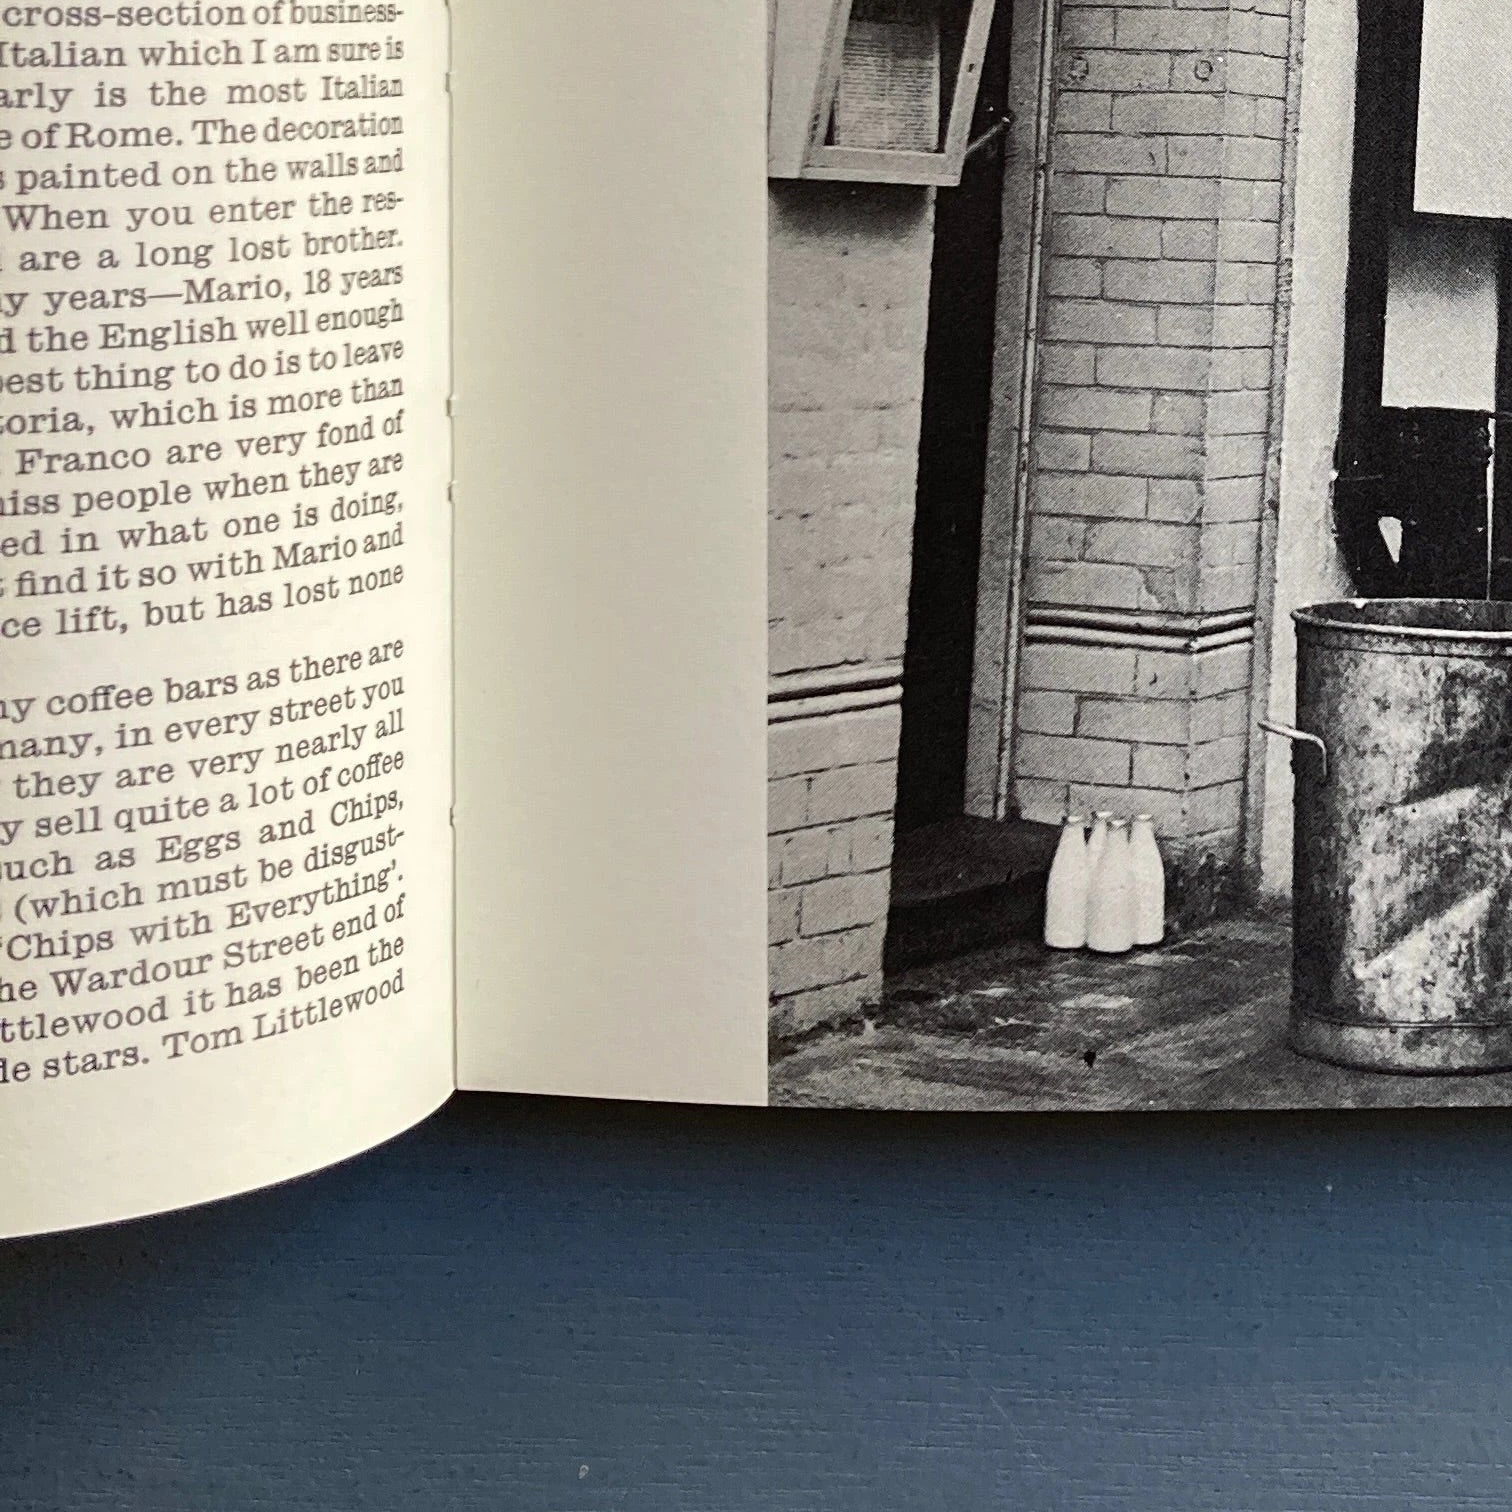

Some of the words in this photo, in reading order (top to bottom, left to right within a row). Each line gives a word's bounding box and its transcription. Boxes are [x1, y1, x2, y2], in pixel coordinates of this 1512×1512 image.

[2, 0, 247, 26] cross-section
[290, 0, 403, 24] business-
[138, 40, 243, 66] which
[274, 44, 321, 63] am
[327, 42, 380, 61] sure
[386, 36, 403, 60] is
[149, 81, 206, 106] the
[226, 79, 306, 104] most
[321, 75, 403, 100] Italian
[65, 123, 182, 148] Rome.
[192, 119, 256, 144] The
[263, 113, 403, 142] decoration
[16, 161, 162, 195] painted
[172, 166, 215, 185] on
[225, 158, 276, 182] the
[286, 153, 358, 179] walls
[364, 148, 404, 174] and
[2, 204, 110, 231] When
[126, 207, 194, 232] you
[210, 198, 296, 223] enter
[308, 192, 352, 216] the
[362, 192, 403, 212] res-
[19, 251, 81, 271] are
[136, 242, 214, 268] long
[229, 235, 290, 262] lost
[303, 226, 402, 256] brother.
[305, 269, 331, 294] 18
[340, 266, 402, 295] years
[26, 326, 88, 352] the
[99, 316, 238, 351] English
[246, 310, 309, 338] well
[316, 298, 404, 331] enough
[74, 363, 175, 390] thing
[230, 354, 266, 380] do
[344, 341, 403, 367] leave
[110, 398, 218, 428] which
[229, 394, 257, 420] is
[267, 389, 342, 415] more
[351, 378, 403, 404] than
[16, 448, 151, 475] Franco
[167, 442, 222, 464] are
[235, 432, 307, 457] very
[317, 416, 375, 448] fond
[72, 480, 191, 517] people
[203, 473, 289, 500] when
[299, 462, 361, 488] they
[368, 453, 403, 476] are
[61, 528, 100, 553] in
[117, 517, 207, 548] what
[224, 514, 280, 537] one
[293, 503, 318, 528] is
[331, 492, 402, 522] doing,
[15, 567, 88, 597] find
[139, 565, 176, 587] so
[187, 550, 265, 581] with
[273, 536, 356, 570] Mario
[363, 522, 404, 553] and
[56, 606, 127, 634] lift,
[142, 597, 204, 626] but
[216, 592, 272, 618] has
[284, 576, 339, 608] lost
[348, 565, 403, 595] none
[47, 685, 153, 715] coffee
[164, 675, 238, 704] bars
[247, 668, 280, 691] as
[289, 652, 362, 682] there
[369, 640, 403, 665] are
[0, 733, 103, 760] many,
[165, 710, 260, 742] every
[270, 686, 355, 726] street
[362, 677, 404, 709] you
[13, 772, 102, 799] they
[116, 764, 174, 788] are
[188, 748, 264, 778] very
[275, 724, 367, 763] nearly
[376, 708, 404, 738] all
[36, 806, 102, 838] sell
[115, 796, 209, 832] quite
[248, 777, 294, 808] lot
[303, 767, 332, 795] of
[338, 752, 403, 786] coffee
[95, 848, 135, 870] as
[156, 831, 241, 863] Eggs
[259, 810, 315, 844] and
[331, 790, 402, 826] Chips,
[15, 882, 144, 924] (which
[157, 864, 248, 902] must
[258, 858, 293, 883] be
[304, 824, 404, 872] disgust-
[50, 954, 213, 996] Wardour
[224, 924, 324, 969] Street
[332, 905, 377, 940] end
[130, 910, 213, 945] with
[225, 977, 281, 1007] has
[295, 955, 360, 990] been
[368, 937, 403, 966] the
[43, 1046, 149, 1079] stars.
[162, 1026, 243, 1058] Tom
[253, 968, 404, 1040] Littlewood
